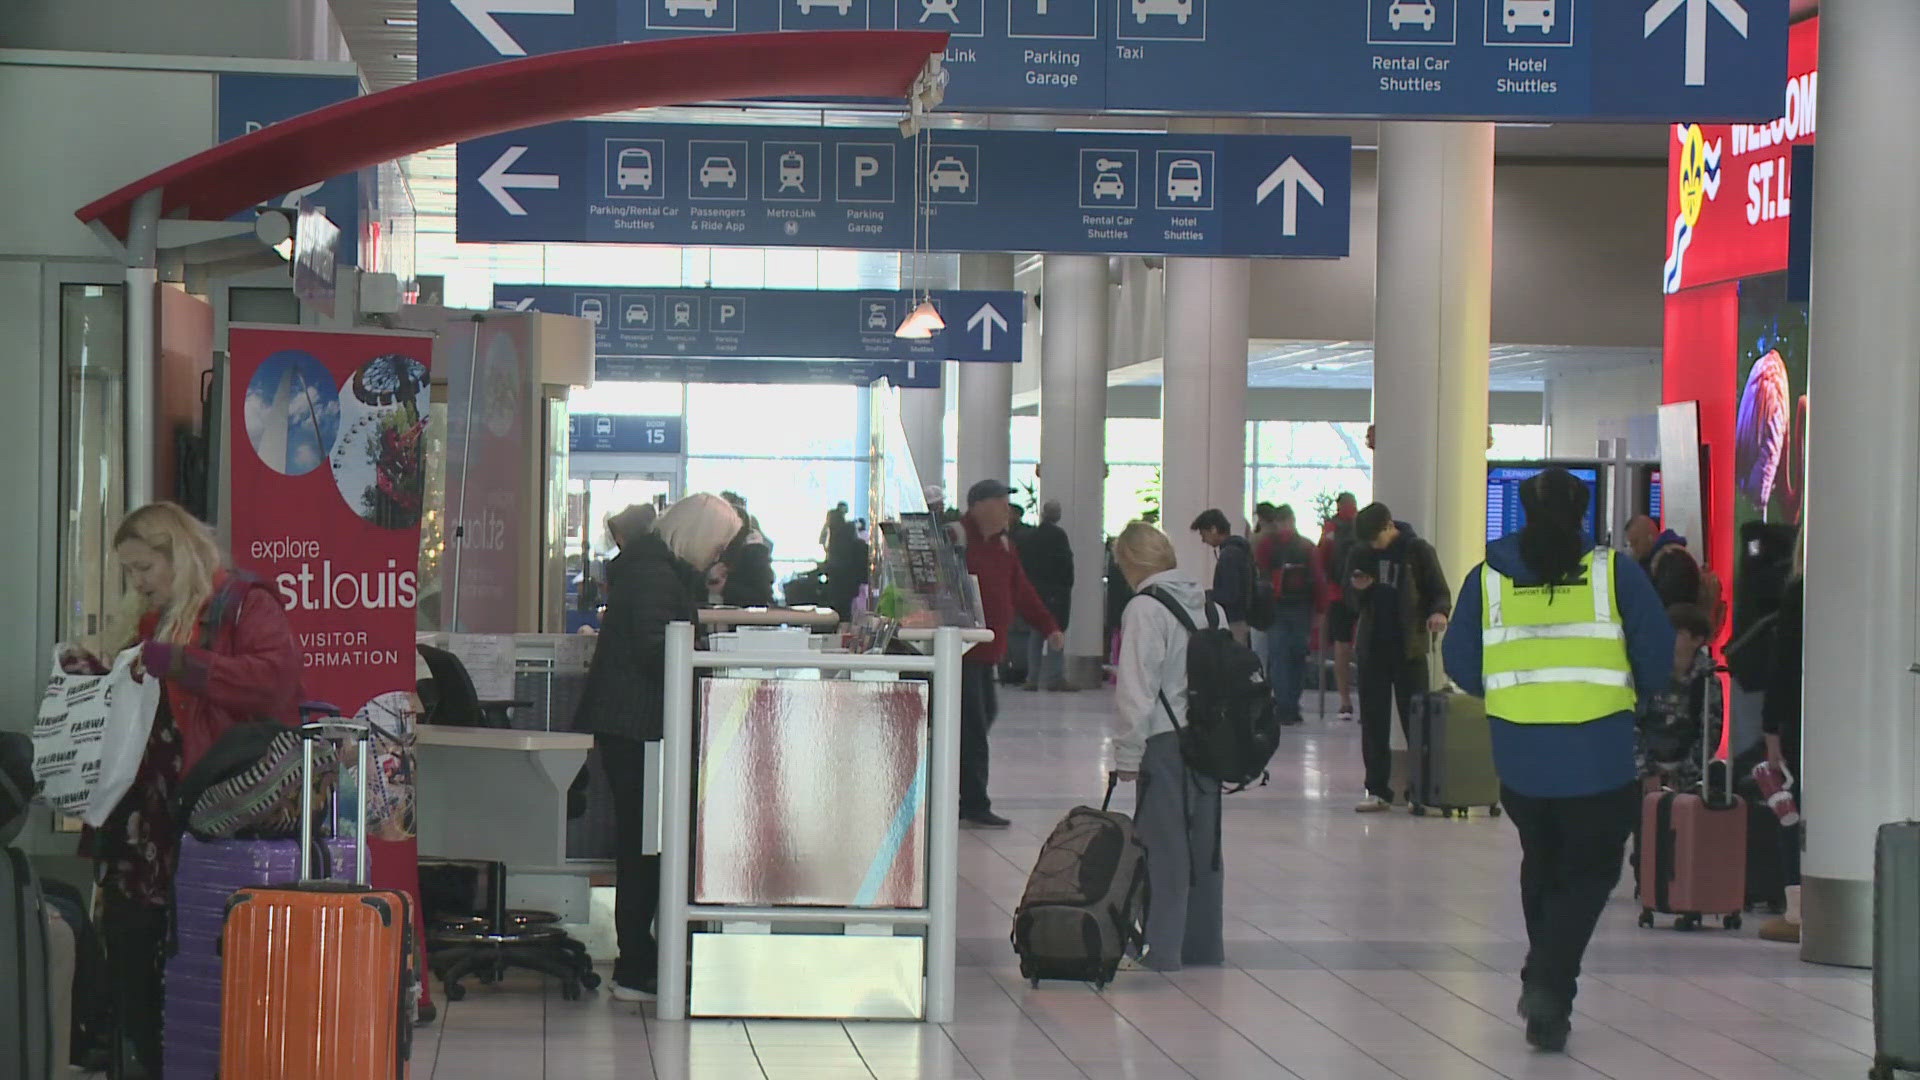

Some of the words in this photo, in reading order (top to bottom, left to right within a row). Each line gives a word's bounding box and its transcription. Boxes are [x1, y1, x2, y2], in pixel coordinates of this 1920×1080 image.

[1024, 50, 1080, 67] Parking
[1116, 45, 1144, 60] Taxi
[1372, 56, 1419, 71] Rental
[1424, 56, 1450, 71] Car
[1508, 57, 1547, 72] Hotel
[1025, 70, 1078, 88] Garage
[1380, 77, 1441, 91] Shuttles
[1497, 78, 1557, 93] Shuttles
[590, 204, 660, 218] Parking/Rental
[662, 206, 679, 216] Car
[690, 207, 746, 218] Passengers
[767, 208, 816, 218] MetroLink
[847, 209, 884, 221] Parking
[614, 219, 655, 230] Shuttles
[691, 222, 698, 230] &
[701, 221, 723, 231] Ride
[725, 222, 745, 232] App
[1083, 215, 1114, 225] Rental
[1117, 215, 1134, 225] Car
[1171, 216, 1197, 227] Hotel
[848, 222, 883, 234] Garage
[1088, 228, 1128, 239] Shuttles
[1164, 230, 1203, 240] Shuttles
[646, 429, 665, 444] 15
[251, 536, 320, 563] explore
[300, 631, 368, 647] VISITOR
[36, 749, 78, 766] FAIRWAY
